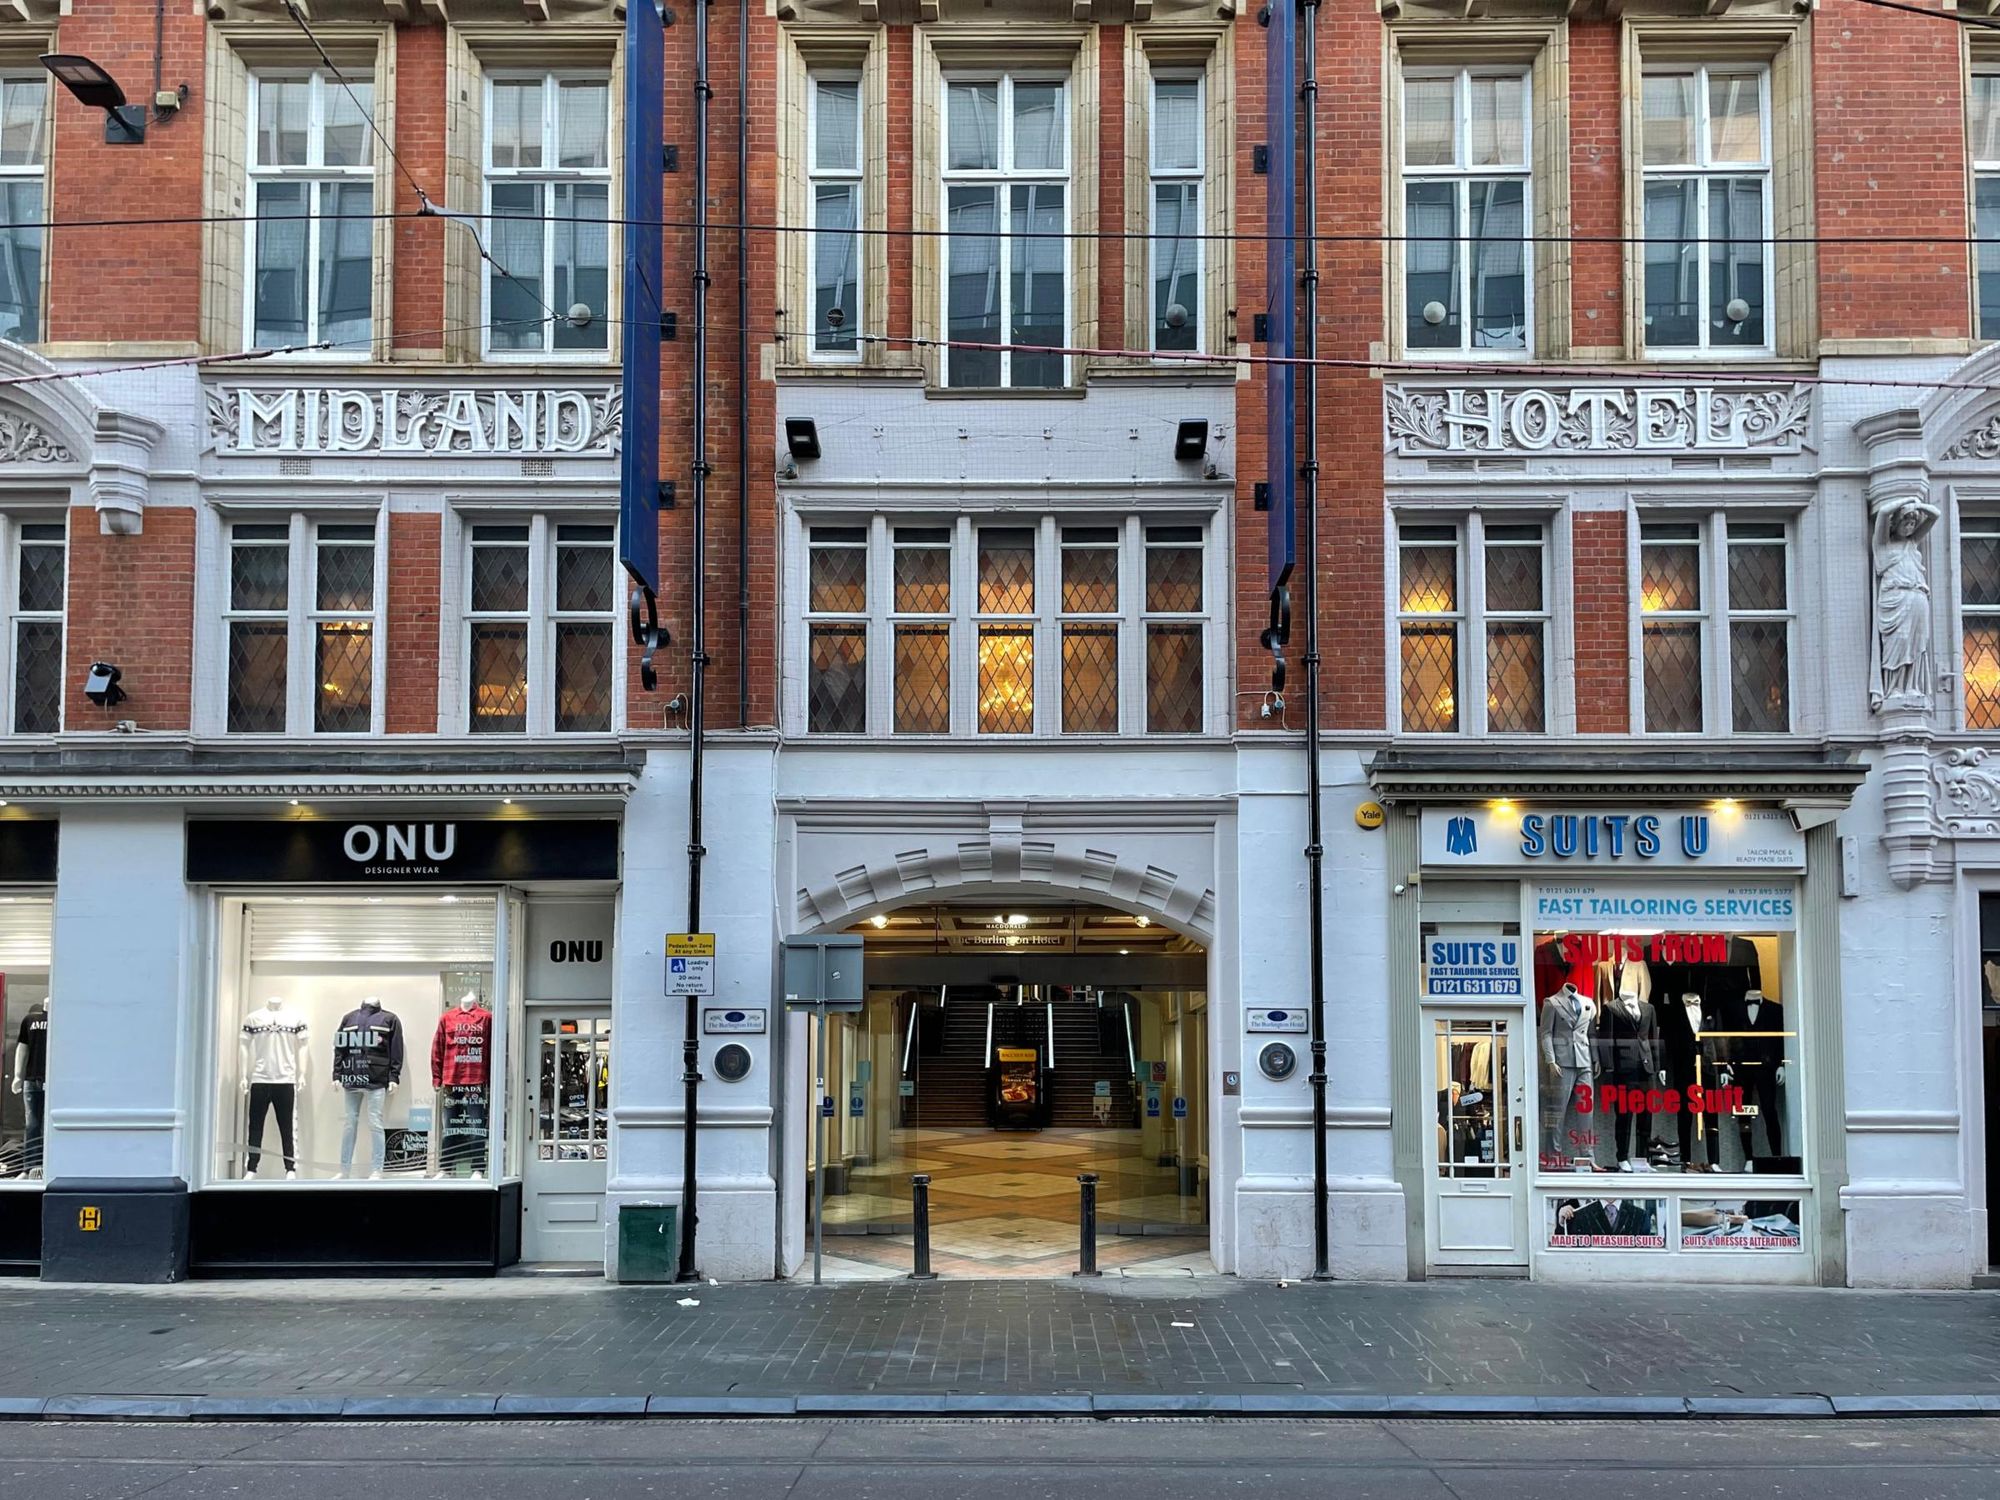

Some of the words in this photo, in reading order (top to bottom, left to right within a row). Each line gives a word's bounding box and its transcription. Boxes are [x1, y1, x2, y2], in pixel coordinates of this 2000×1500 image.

[237, 389, 592, 453] MIDLAND
[1443, 387, 1751, 451] HOTEL
[1361, 810, 1380, 819] Yale
[343, 823, 455, 861] ONU
[1520, 815, 1661, 857] SUITS
[1681, 815, 1710, 857] U
[1538, 898, 1583, 914] FAST
[1590, 898, 1697, 915] TAILORING
[1704, 899, 1793, 915] SERVICES
[1032, 936, 1061, 944] Hotel
[550, 940, 603, 962] ONU
[1432, 942, 1497, 965] SUITS
[1502, 942, 1516, 965] U
[1563, 934, 1644, 963] SUITS
[1651, 934, 1727, 963] FROM
[1430, 968, 1448, 976] FAST
[1449, 968, 1487, 976] TAILORING
[1489, 968, 1519, 976] SERVICE
[1433, 980, 1461, 993] 0121
[1463, 980, 1486, 993] 631
[1488, 980, 1517, 993] 1679
[456, 1023, 483, 1031] BOSS
[1261, 1021, 1289, 1029] Burlington
[335, 1032, 378, 1047] ONU
[454, 1036, 484, 1044] KENZO
[467, 1047, 482, 1055] LOVE
[341, 1074, 370, 1083] BOSS
[1575, 1084, 1592, 1114] 3
[1601, 1084, 1681, 1114] Piece
[1687, 1084, 1744, 1114] Suit
[1551, 1236, 1577, 1246] MADE
[1579, 1236, 1590, 1246] TO
[1592, 1236, 1634, 1246] MEASURE
[1636, 1236, 1663, 1246] SUITS
[1684, 1236, 1706, 1246] SUITS
[1715, 1236, 1748, 1246] DRESSES
[1750, 1236, 1797, 1247] ALTERATIONS
